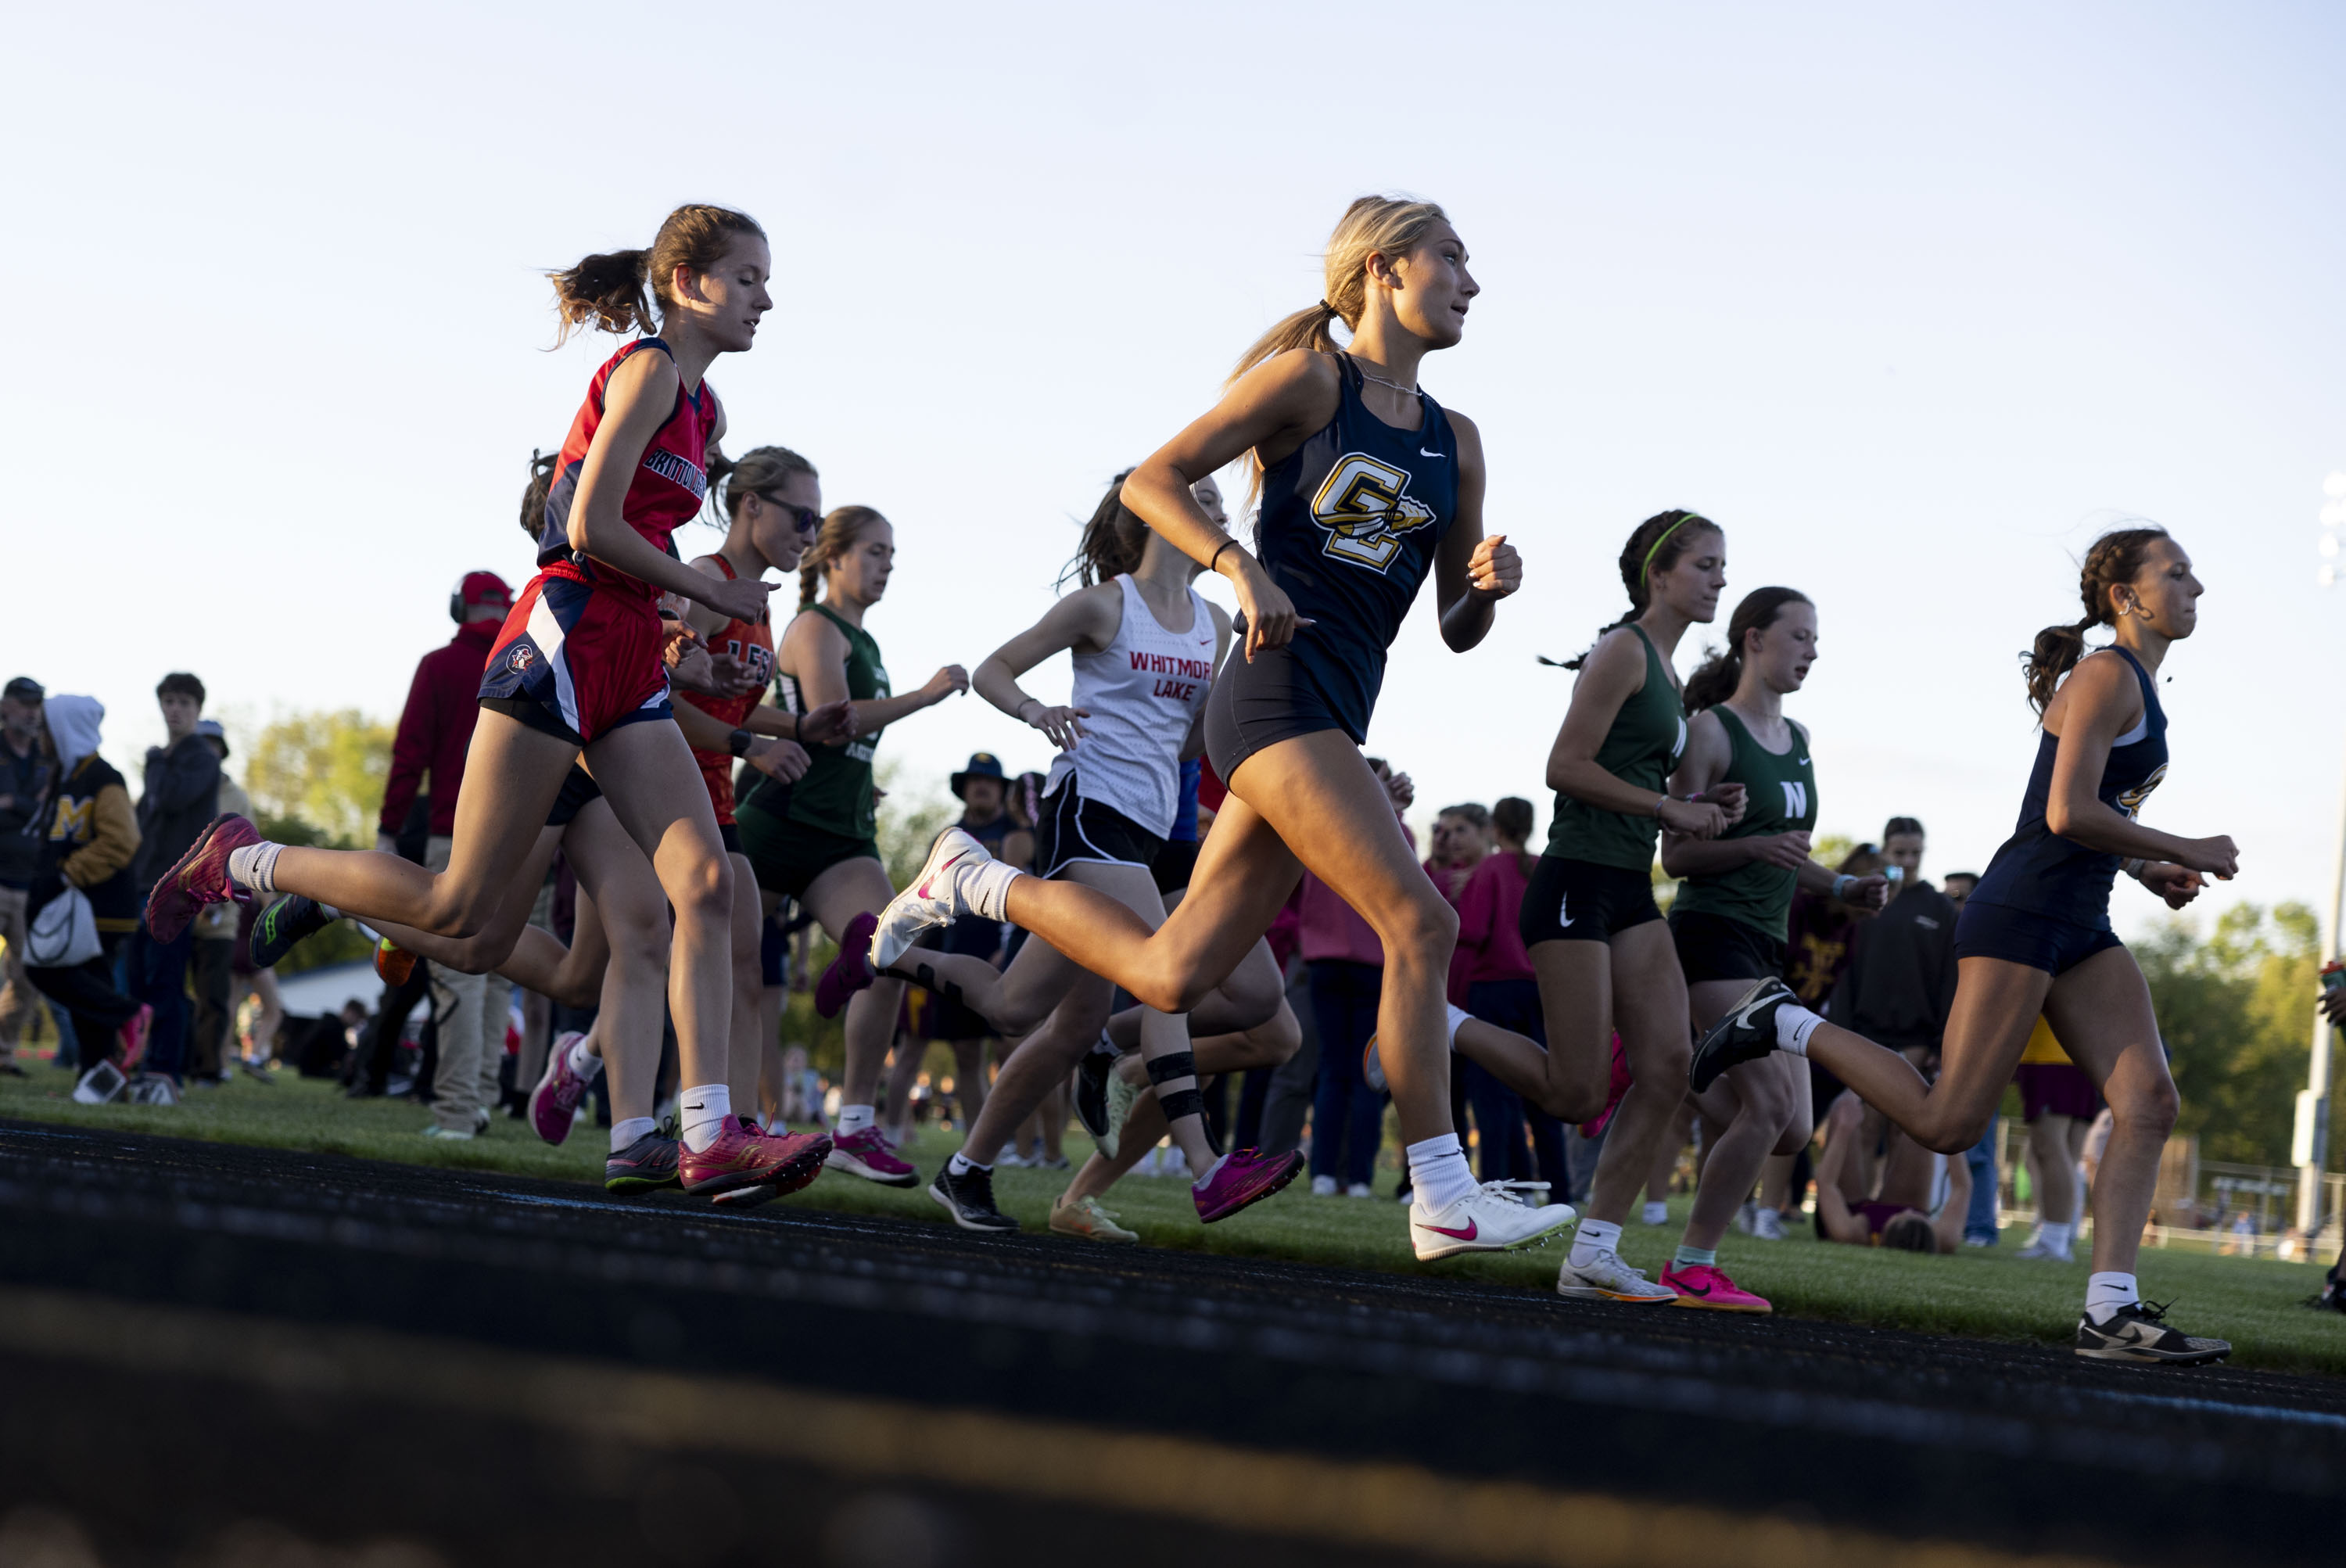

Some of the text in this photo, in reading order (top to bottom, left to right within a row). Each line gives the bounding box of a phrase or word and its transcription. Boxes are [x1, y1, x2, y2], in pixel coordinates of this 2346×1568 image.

[1129, 651, 1213, 682] WHITMOR
[1153, 679, 1197, 701] LAKE
[1780, 781, 1807, 819] N
[49, 795, 93, 841] M
